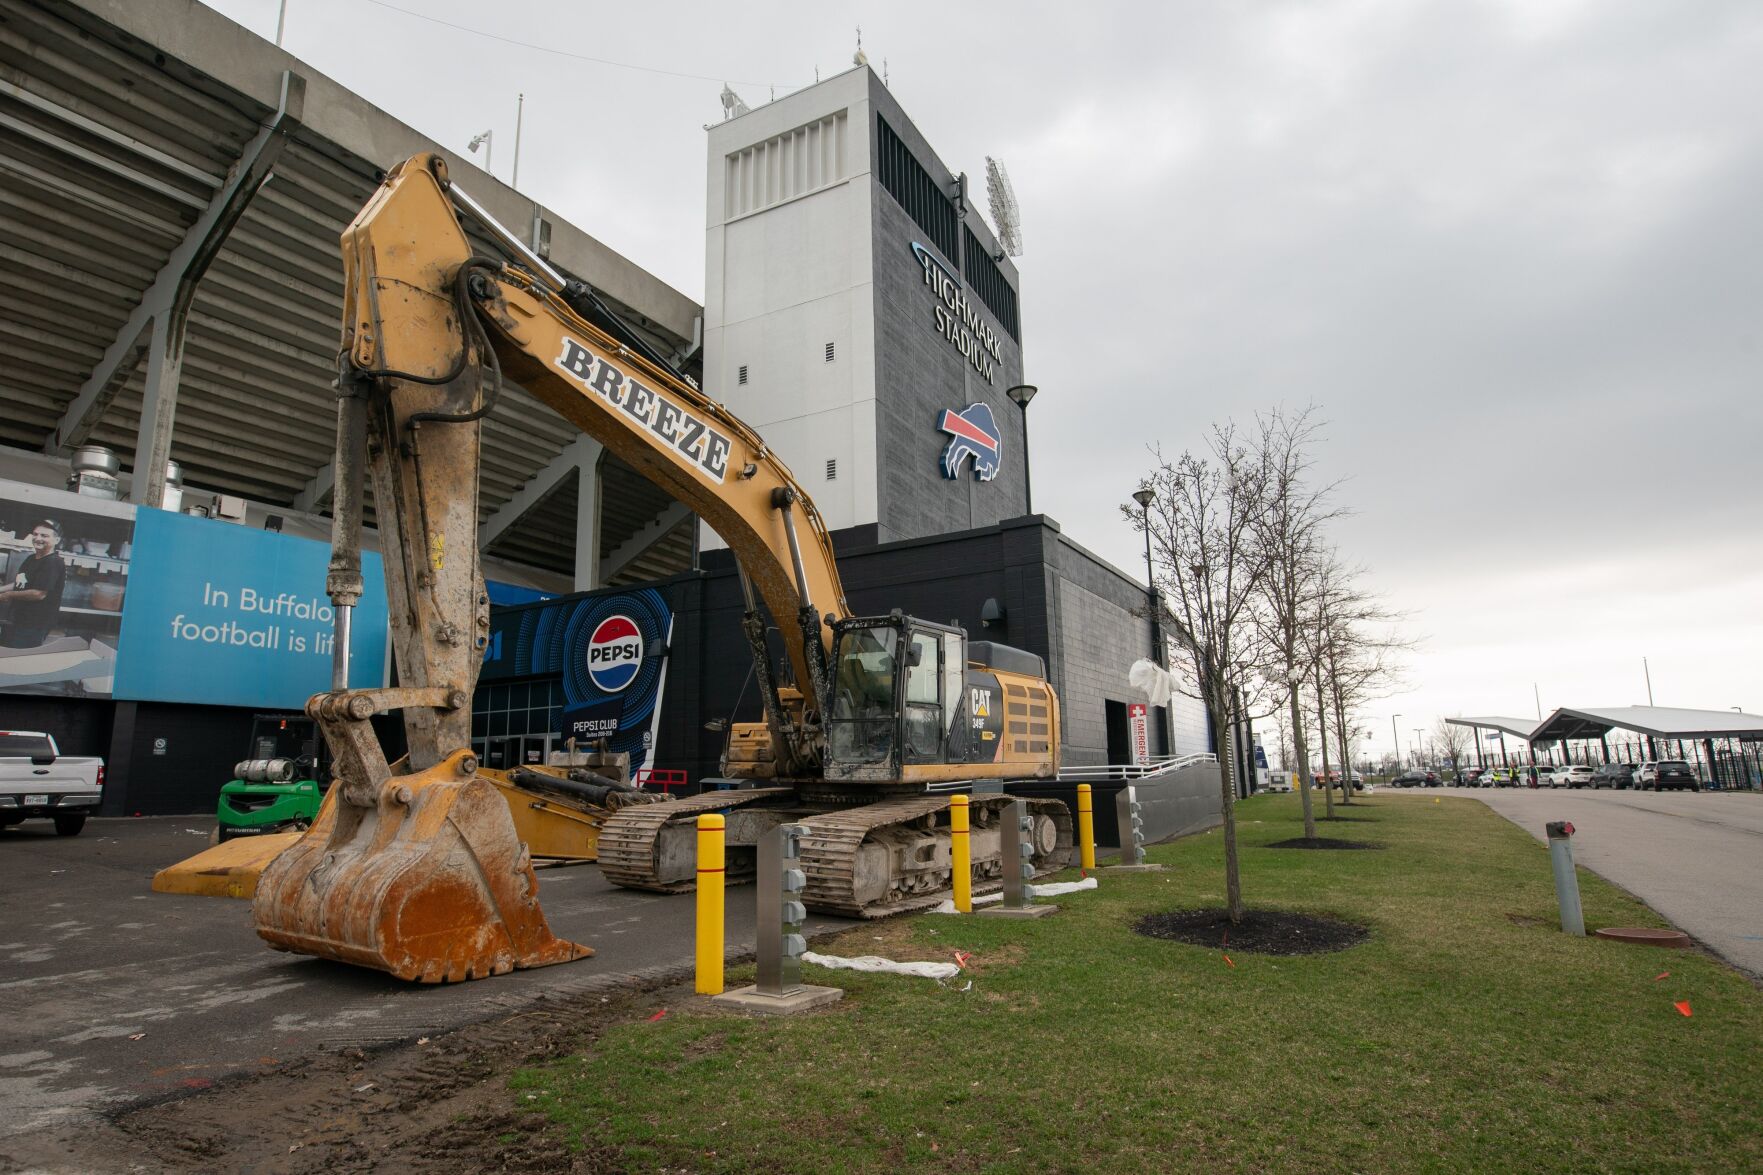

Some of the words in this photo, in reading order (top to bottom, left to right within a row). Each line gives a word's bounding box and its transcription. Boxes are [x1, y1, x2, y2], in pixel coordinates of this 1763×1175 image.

[924, 255, 1003, 366] HIGHMARK
[935, 305, 994, 385] STADIUM
[556, 337, 732, 483] BREEZE
[204, 582, 229, 608] In
[171, 615, 280, 649] football
[288, 629, 306, 652] is
[590, 643, 639, 663] PEPSI
[971, 688, 991, 717] CAT
[573, 720, 599, 733] PEPSI
[600, 718, 618, 730] CLUB
